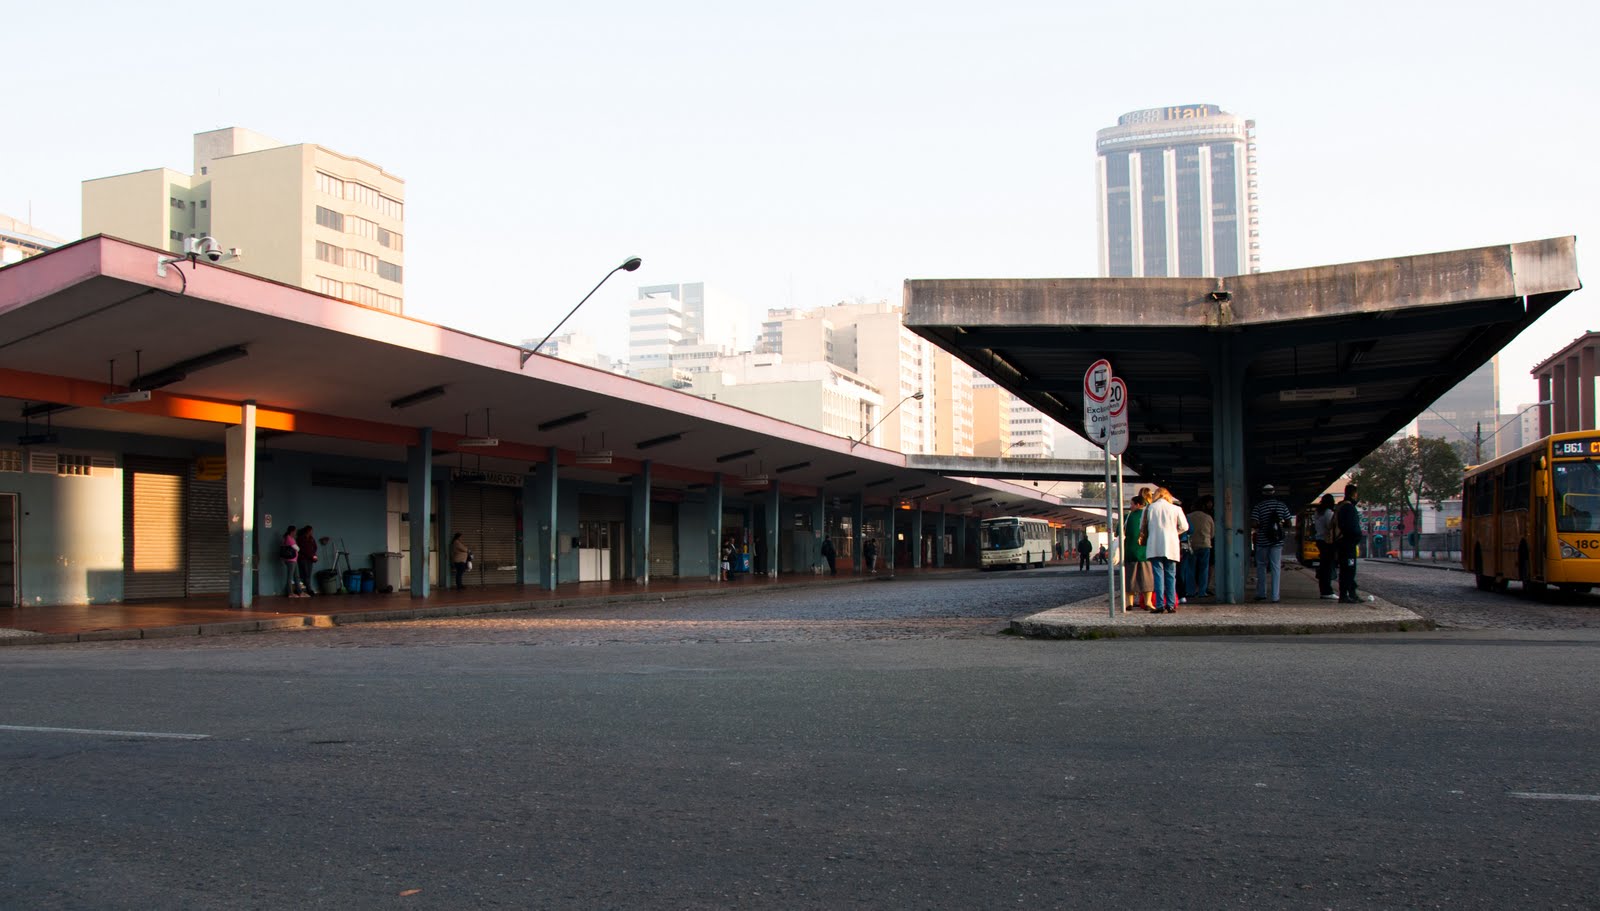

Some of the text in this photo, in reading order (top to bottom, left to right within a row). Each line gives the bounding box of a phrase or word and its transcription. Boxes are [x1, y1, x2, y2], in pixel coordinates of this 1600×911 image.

[1110, 385, 1122, 402] 20
[1563, 442, 1584, 453] B61
[1575, 539, 1599, 549] 18C
